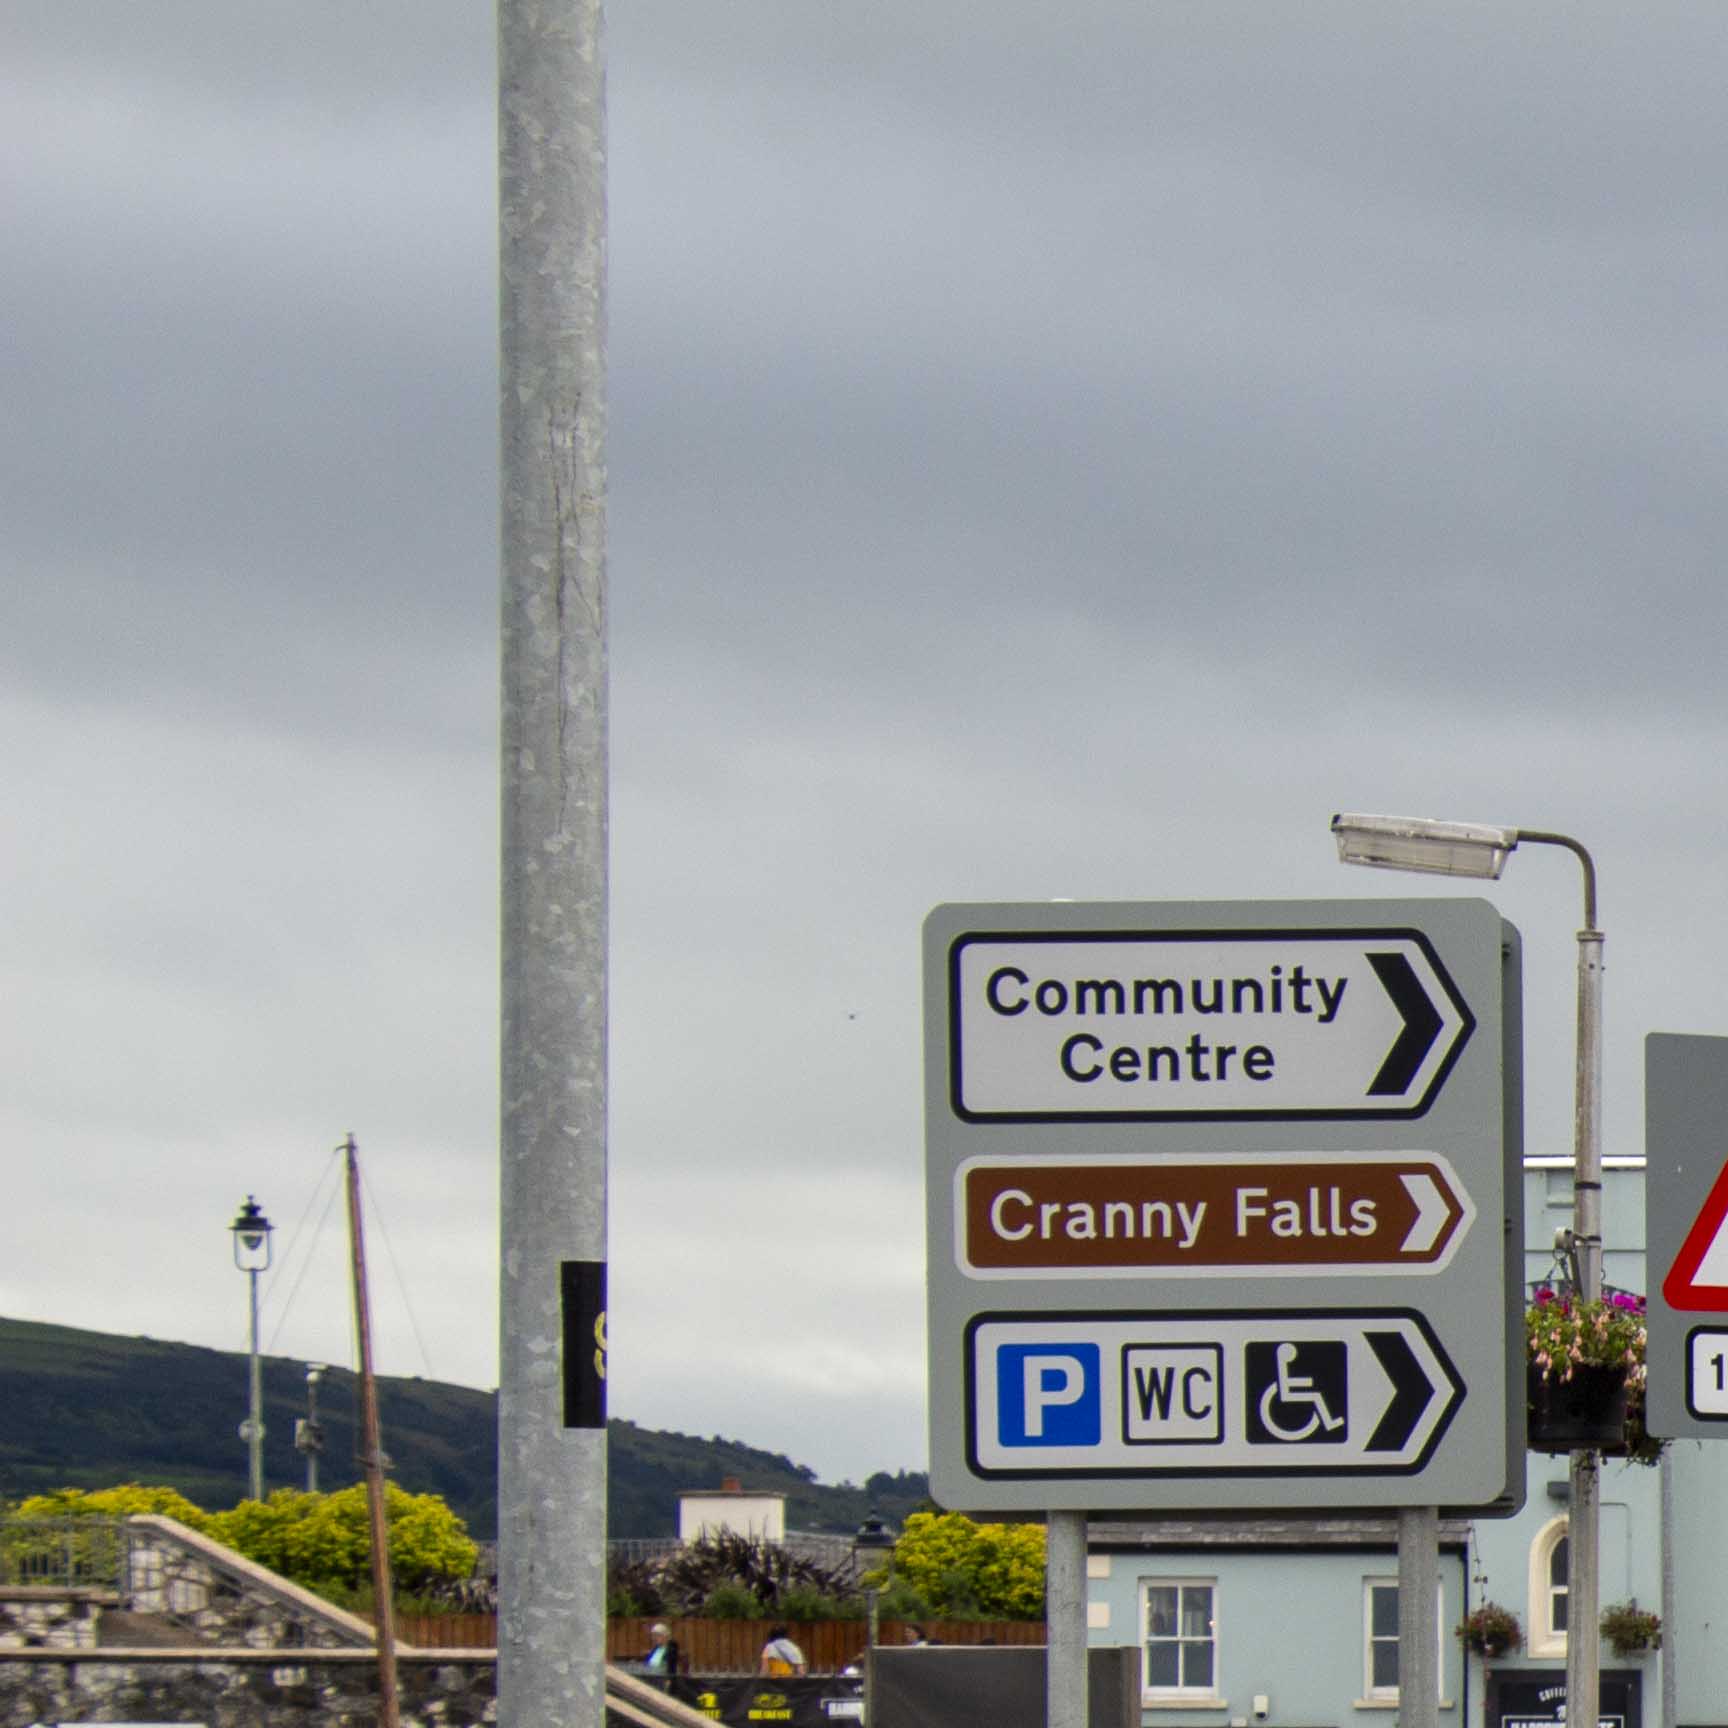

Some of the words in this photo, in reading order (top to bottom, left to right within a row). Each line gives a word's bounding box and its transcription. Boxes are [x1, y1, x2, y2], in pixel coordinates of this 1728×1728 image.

[986, 966, 1348, 1023] Community
[1060, 1034, 1275, 1083] Centre
[990, 1188, 1206, 1248] Cranny
[1236, 1187, 1378, 1238] Falls
[1023, 1355, 1085, 1437] P
[1134, 1366, 1213, 1422] WC
